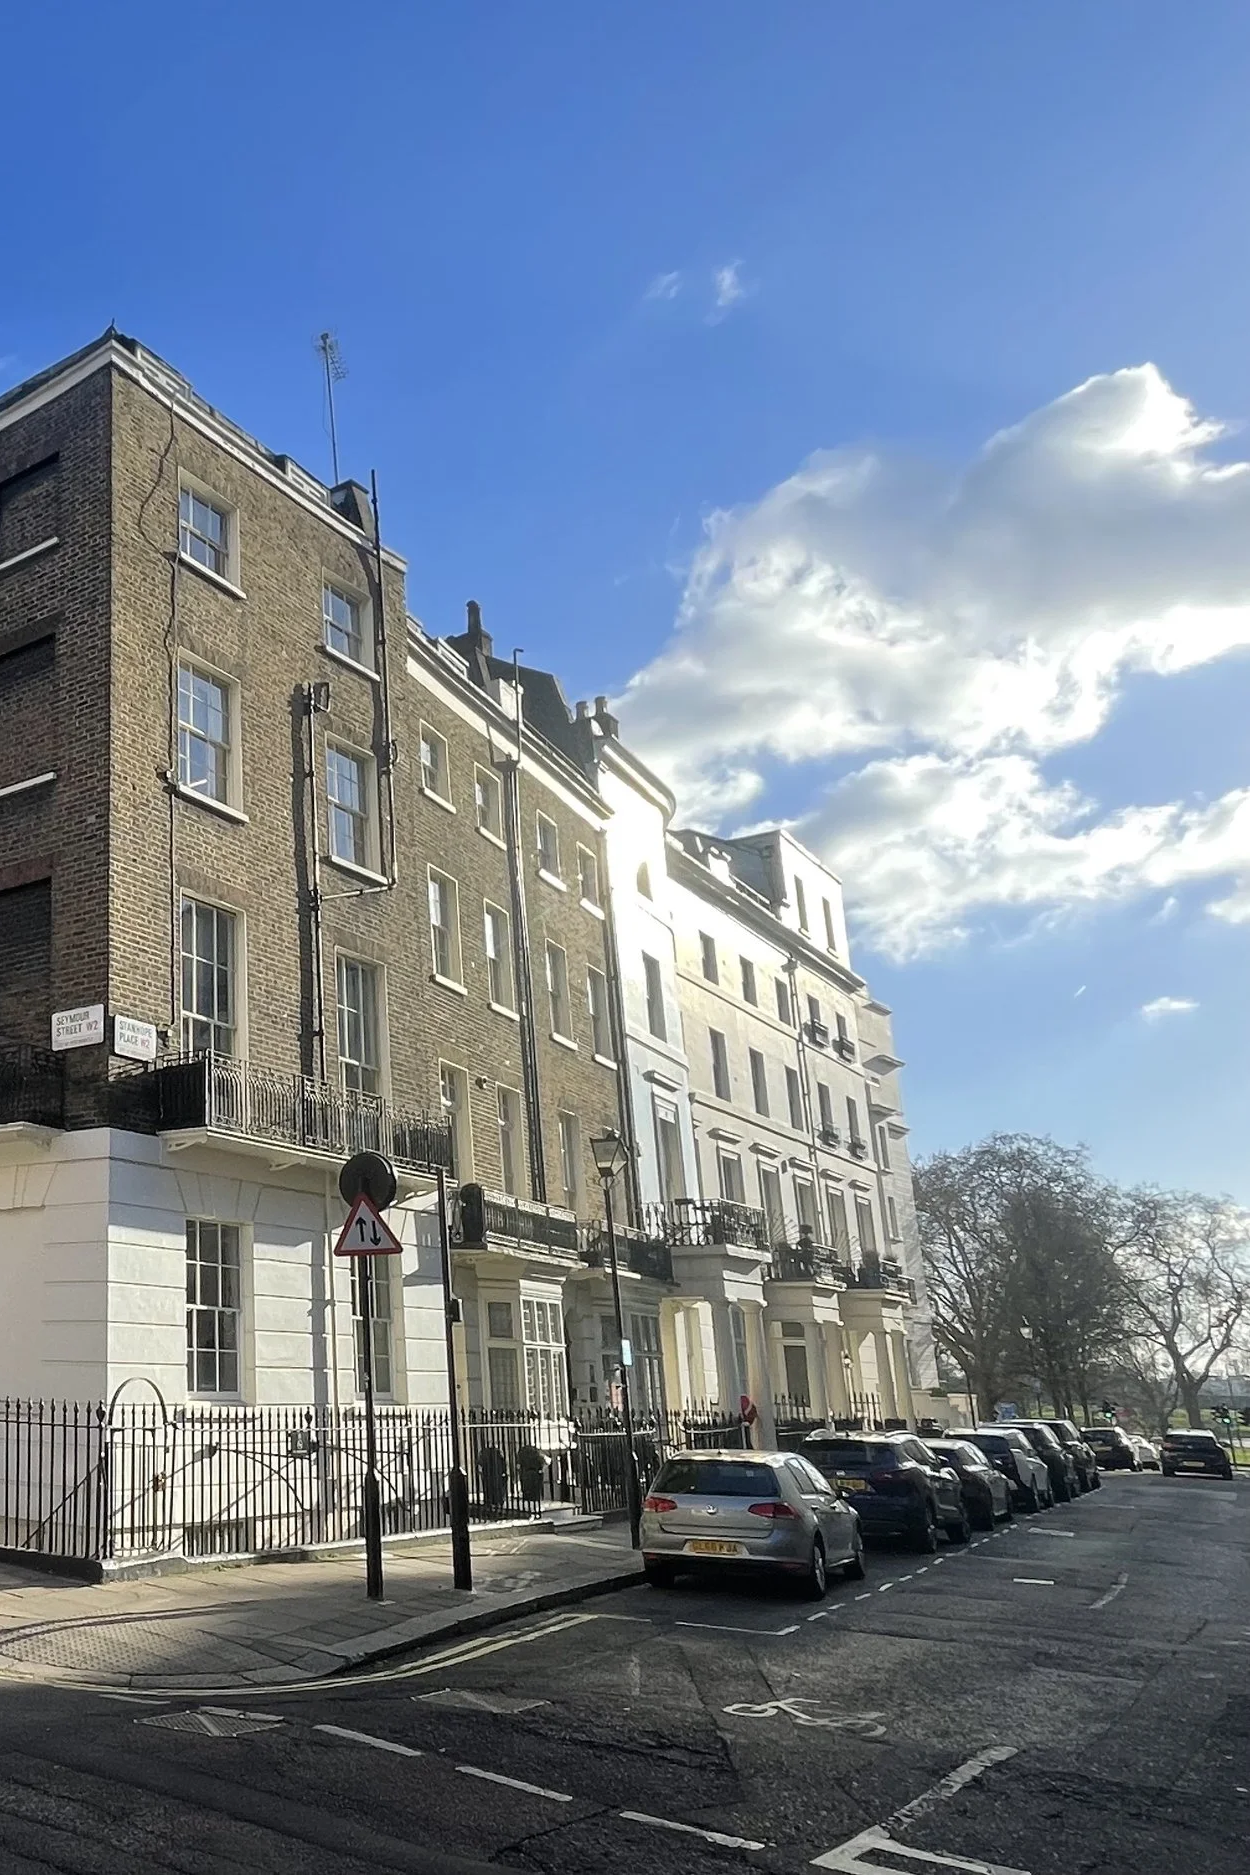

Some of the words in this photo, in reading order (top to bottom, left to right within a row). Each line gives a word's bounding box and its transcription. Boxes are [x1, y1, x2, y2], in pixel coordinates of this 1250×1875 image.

[56, 1011, 90, 1026] SEYMOUR
[56, 1023, 82, 1037] STREET
[86, 1020, 99, 1031] W2
[119, 1032, 138, 1046] PLACE
[140, 1038, 150, 1048] W2
